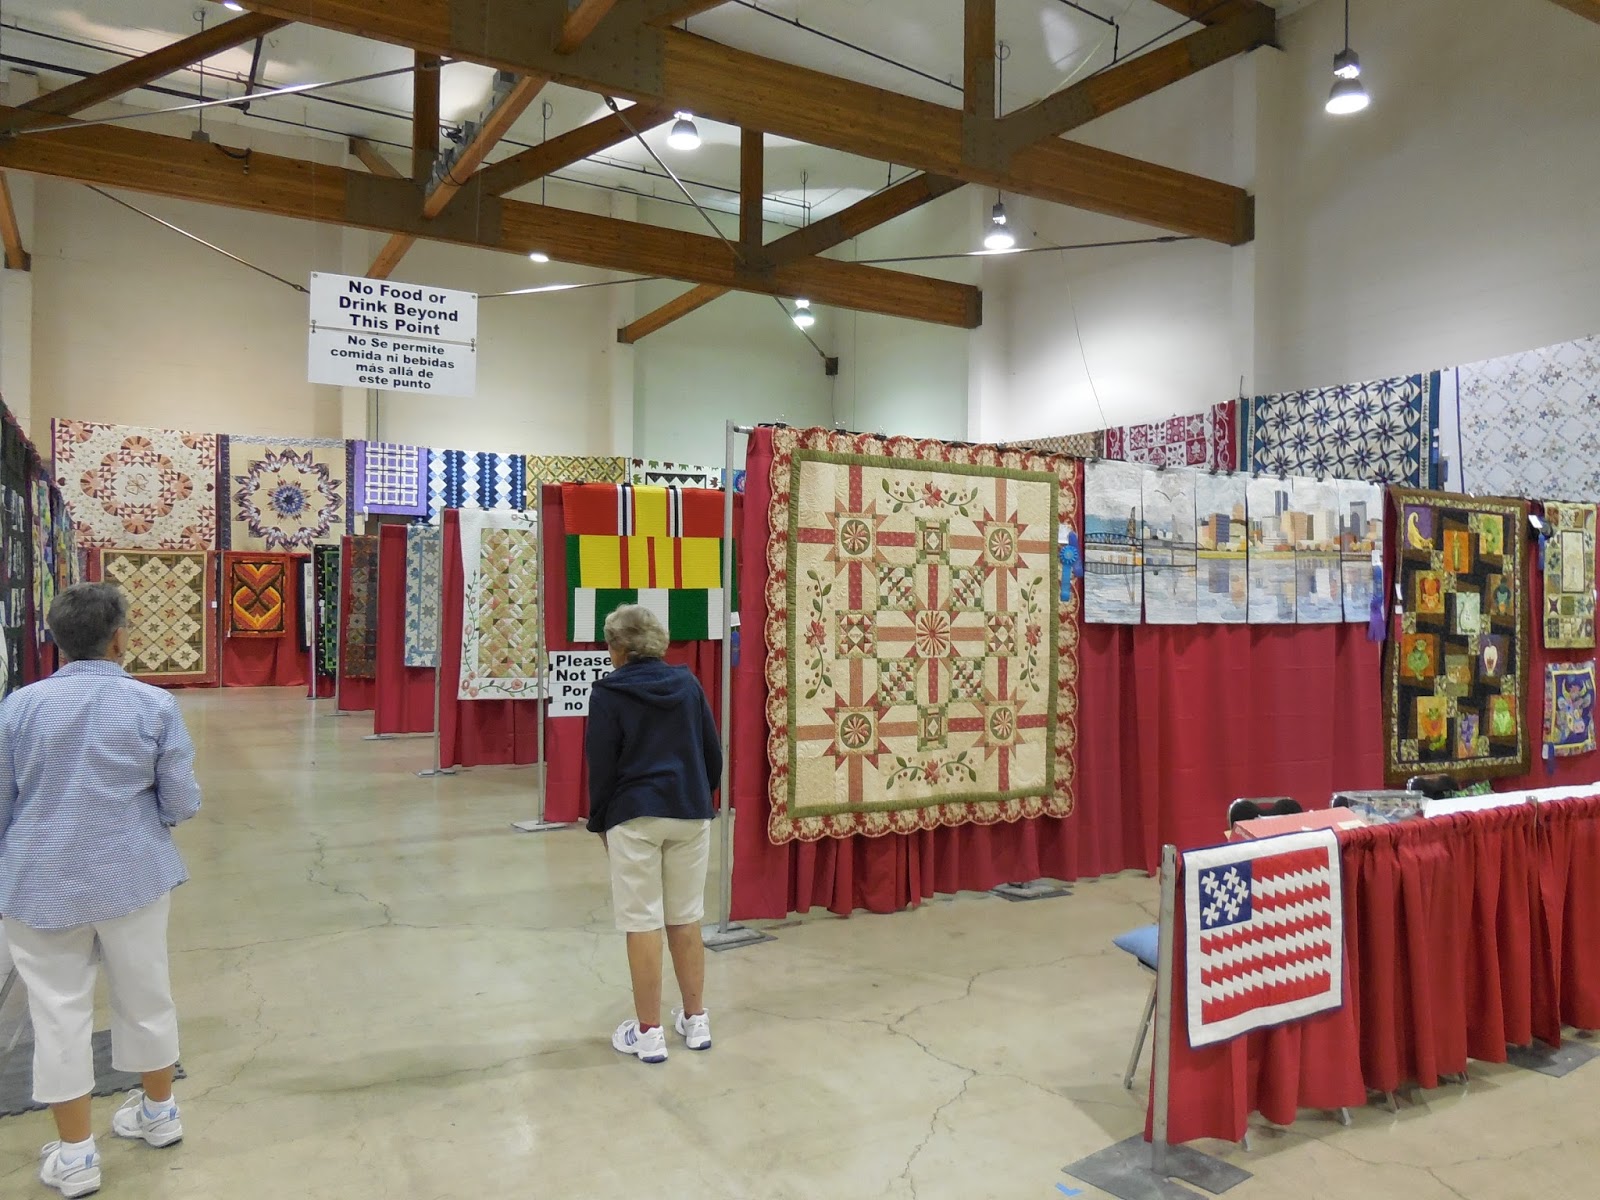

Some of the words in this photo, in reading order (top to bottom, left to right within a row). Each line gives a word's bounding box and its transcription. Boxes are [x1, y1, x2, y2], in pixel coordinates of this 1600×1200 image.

[349, 280, 374, 295] No
[380, 284, 423, 302] Food
[428, 293, 447, 305] or
[339, 295, 387, 314] Drink
[394, 302, 458, 322] Beyond
[350, 313, 389, 330] This
[395, 319, 441, 336] Point
[347, 335, 367, 346] No
[371, 338, 388, 349] Se
[393, 342, 445, 356] permite
[330, 348, 382, 362] comida
[386, 354, 399, 363] ni
[403, 354, 455, 369] bebidas
[355, 362, 384, 374] más
[388, 365, 414, 377] allá
[417, 368, 434, 379] de
[358, 375, 389, 385] este
[393, 378, 431, 389] punto
[556, 655, 612, 667] Please
[556, 669, 586, 682] Not
[562, 685, 588, 697] Por
[564, 701, 583, 711] no
